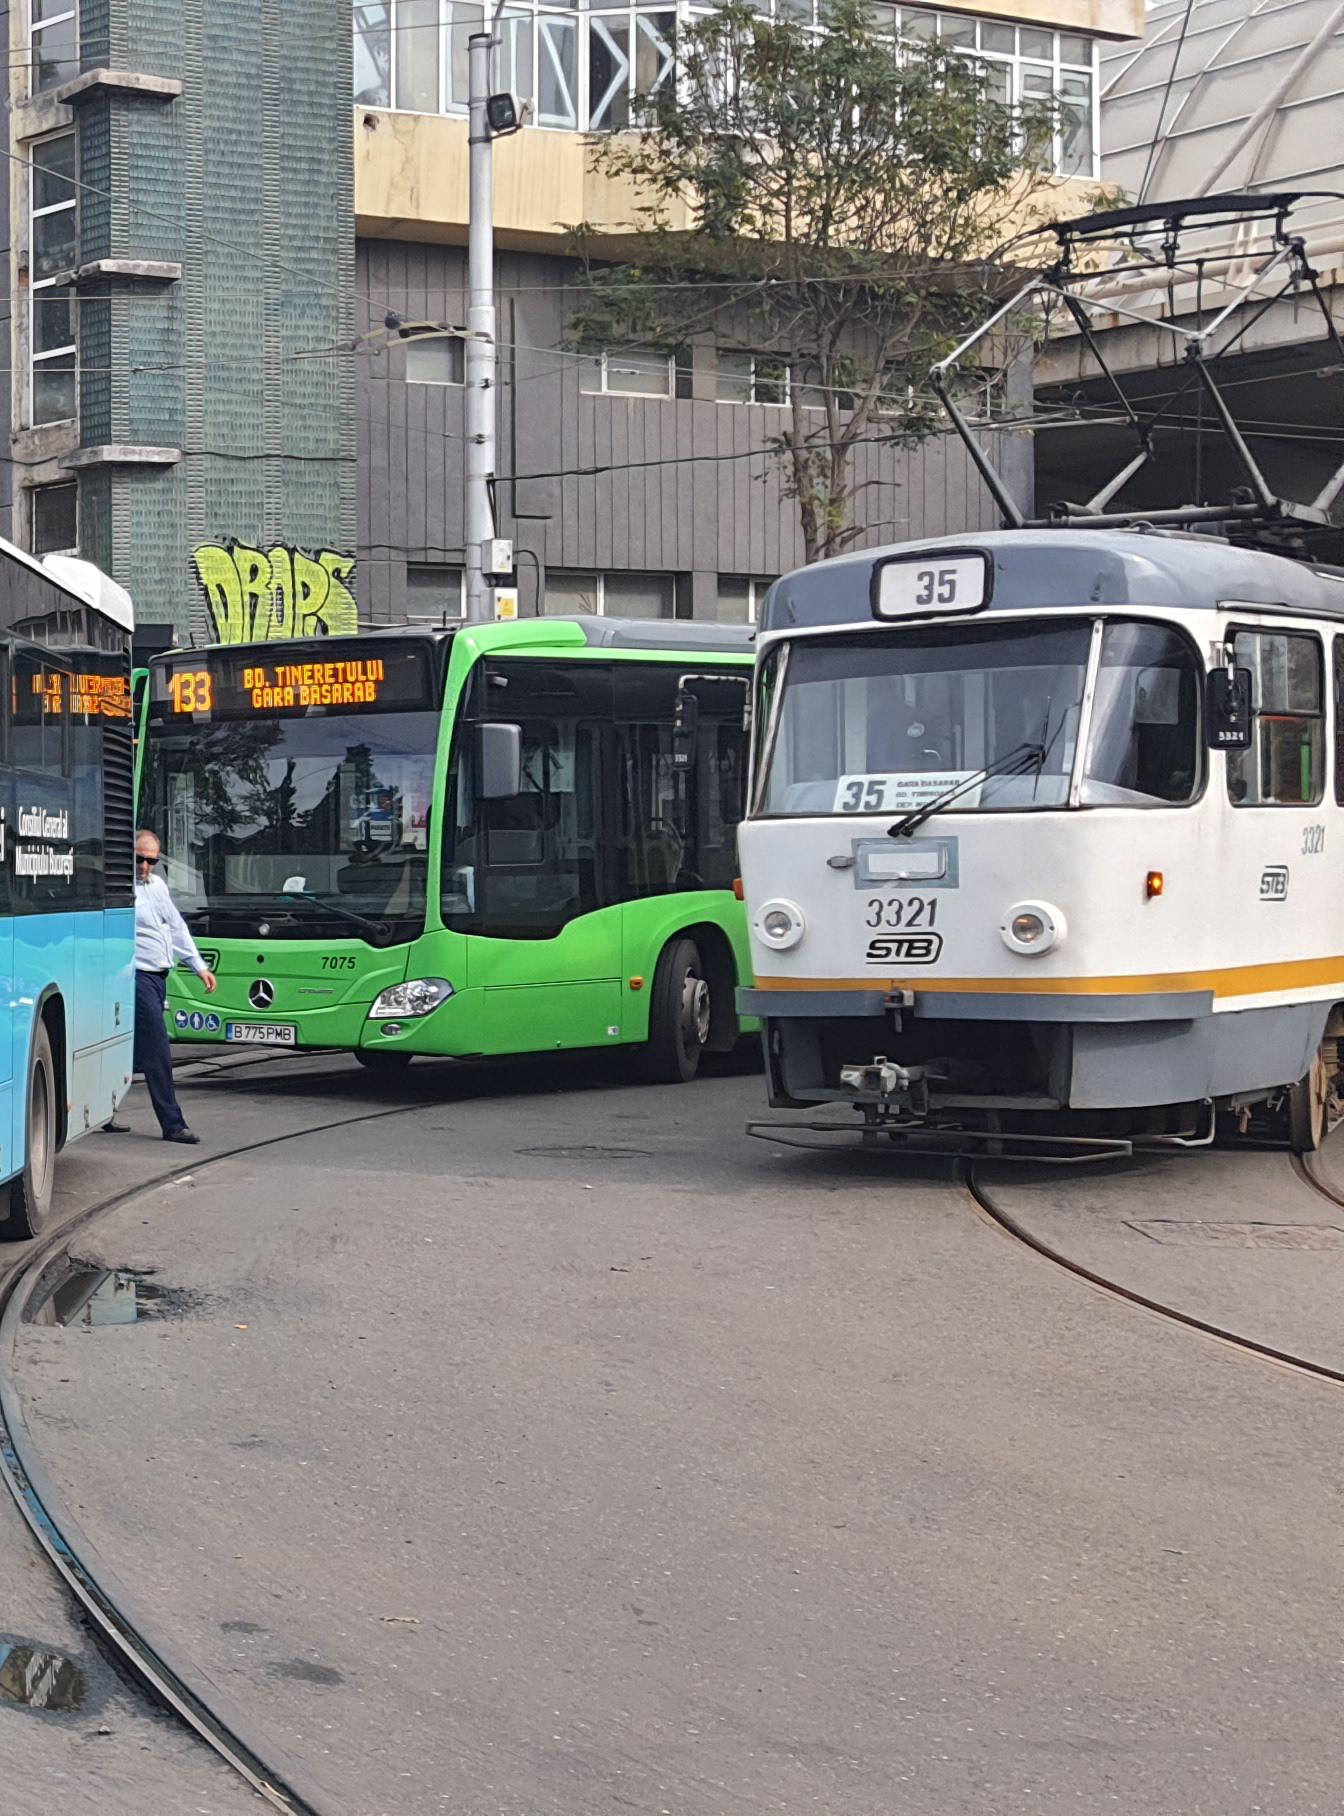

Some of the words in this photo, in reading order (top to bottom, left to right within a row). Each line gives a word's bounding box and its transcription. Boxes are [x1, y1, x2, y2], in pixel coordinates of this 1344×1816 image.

[916, 569, 957, 605] 35
[243, 668, 271, 688] BD.
[275, 660, 384, 687] TINERETULUI
[169, 672, 211, 713] 133
[253, 686, 294, 709] GARA
[300, 682, 376, 706] BASARAB
[842, 780, 887, 812] 35
[1301, 824, 1326, 856] 3321
[1259, 872, 1287, 894] STB
[866, 896, 938, 928] 3321
[864, 937, 935, 960] STB
[321, 956, 356, 970] 7075
[234, 1025, 243, 1039] B
[245, 1025, 265, 1039] 775
[267, 1027, 291, 1040] PMB
